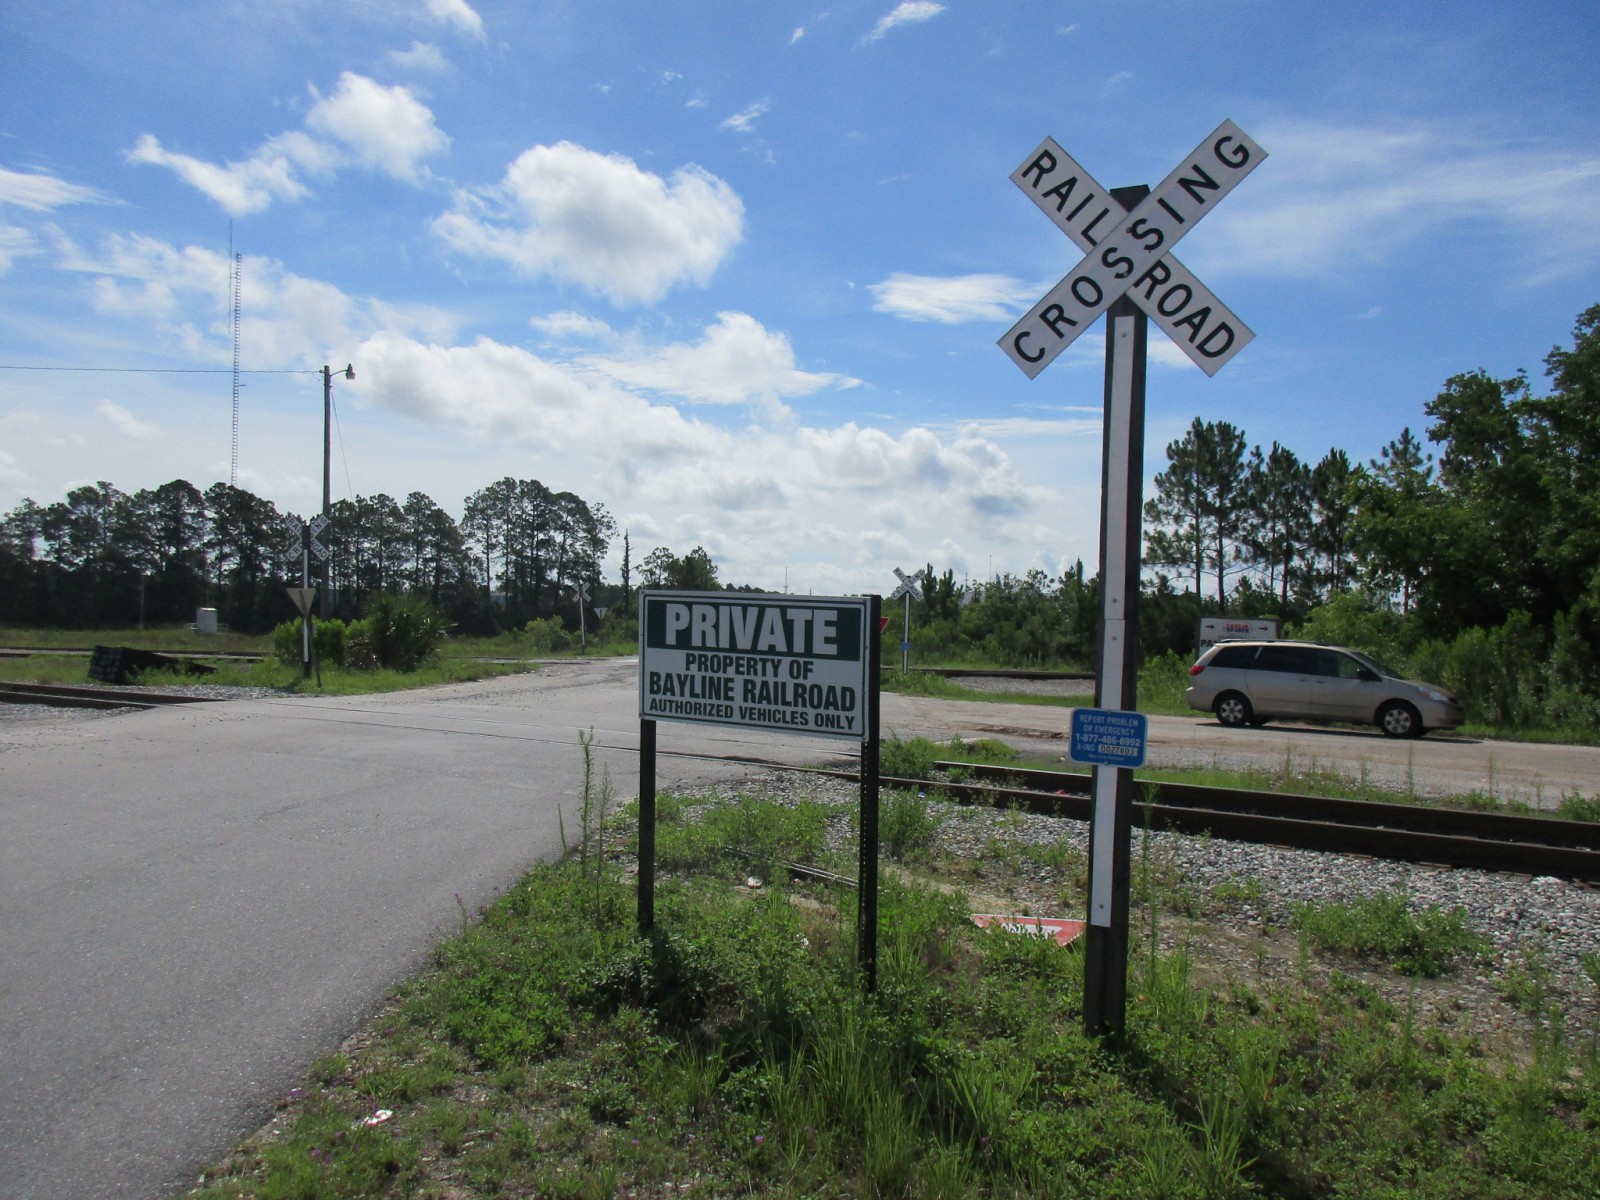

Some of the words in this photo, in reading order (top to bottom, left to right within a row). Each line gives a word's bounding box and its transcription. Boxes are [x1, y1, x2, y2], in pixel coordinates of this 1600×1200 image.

[1014, 135, 1250, 363] CROSSING
[665, 603, 838, 656] PRIVATE
[685, 652, 782, 678] PROPERTY
[789, 659, 814, 680] OF
[649, 671, 735, 702] BAYLINE
[743, 678, 856, 712] RAILROAD
[649, 698, 734, 719] AUTHORIZED
[739, 706, 809, 726] VEHICLES
[814, 713, 856, 731] ONLY
[1079, 714, 1105, 724] REPORT
[1107, 717, 1139, 727] PROBLEM
[1076, 733, 1141, 747] 1-877-486-6992
[1095, 726, 1135, 736] EMERGENCY
